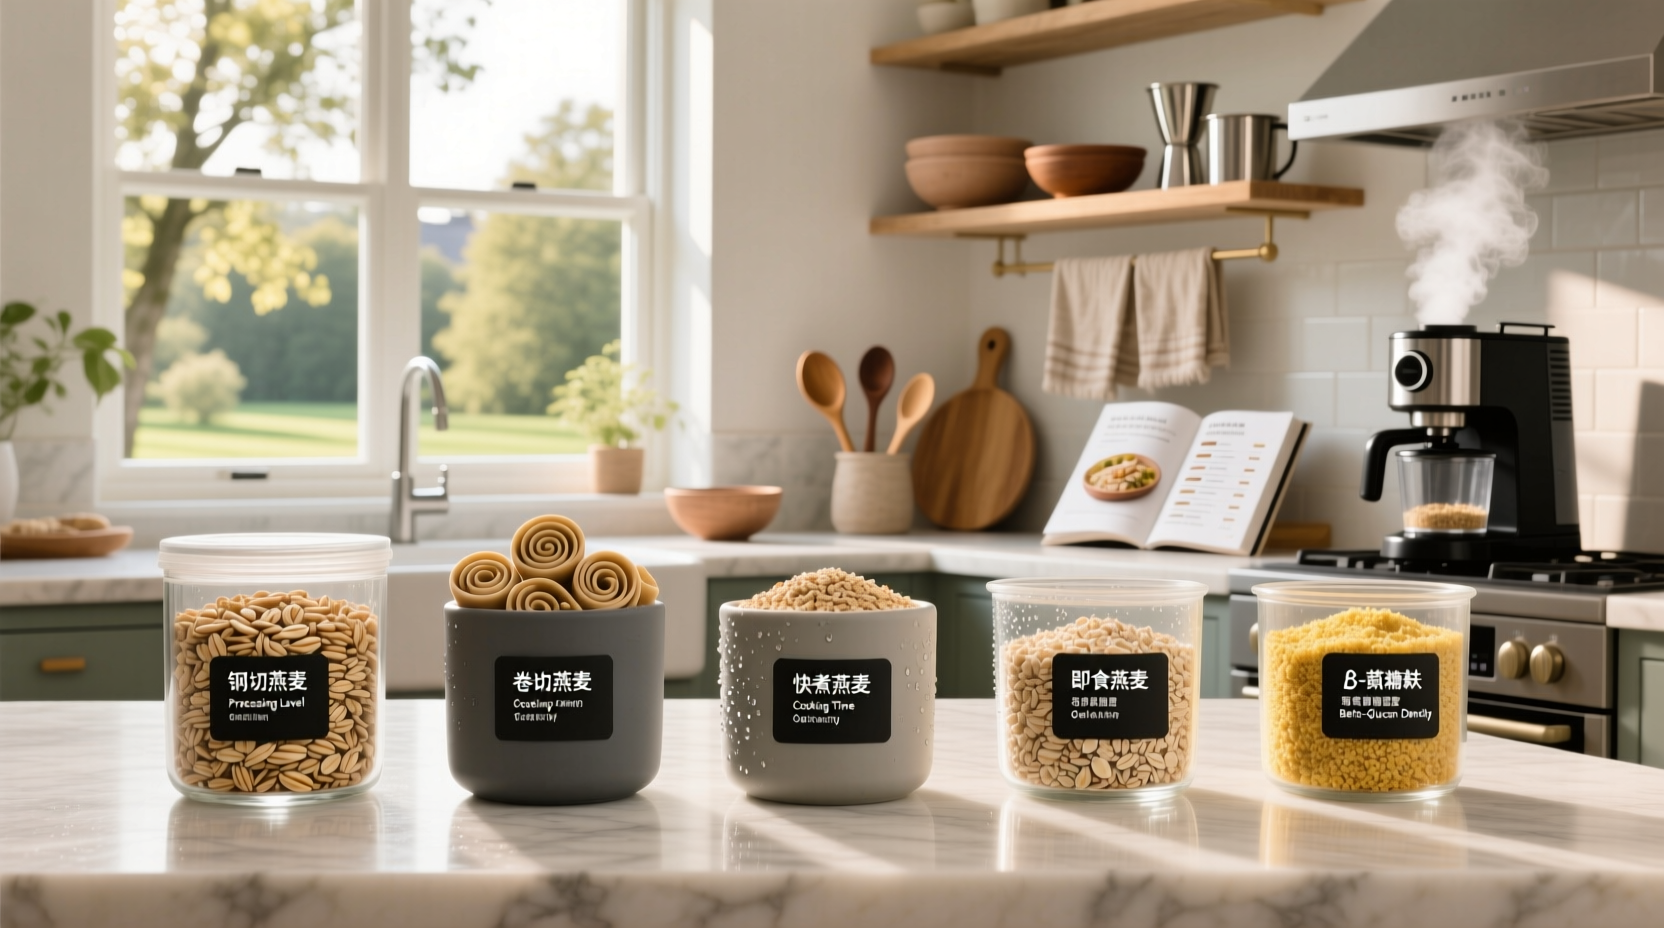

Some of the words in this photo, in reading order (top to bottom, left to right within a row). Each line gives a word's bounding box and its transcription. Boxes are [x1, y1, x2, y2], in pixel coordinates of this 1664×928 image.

[793, 673, 871, 695] 快煮燕麦
[1071, 669, 1149, 690] 即食燕麦
